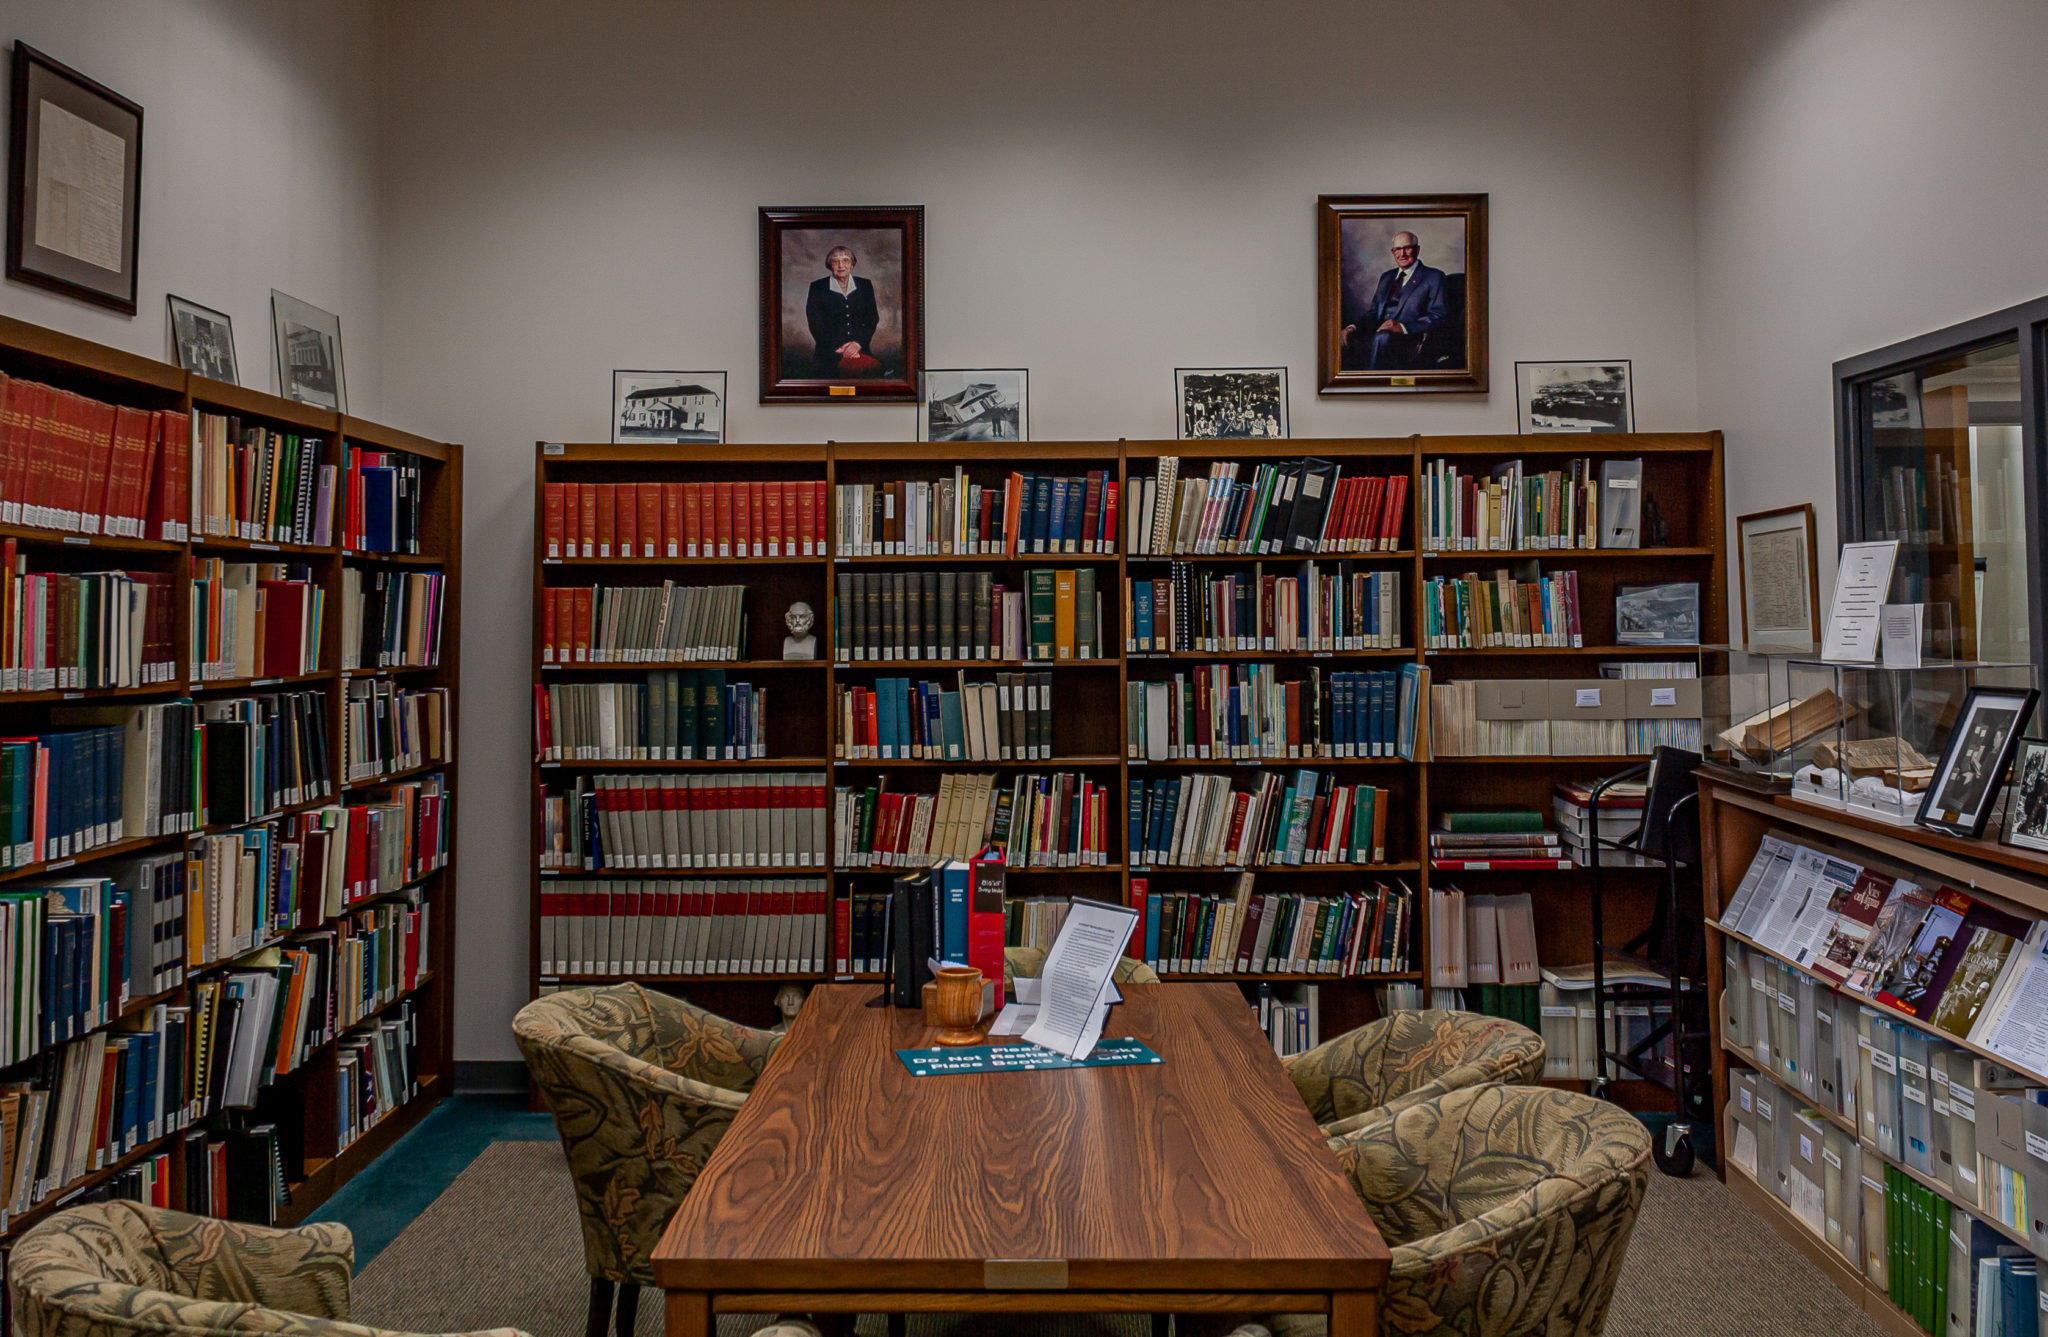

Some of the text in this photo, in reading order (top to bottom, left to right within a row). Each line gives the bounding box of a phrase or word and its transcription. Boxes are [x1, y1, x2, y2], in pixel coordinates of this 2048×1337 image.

[947, 1054, 982, 1062] Not
[930, 1061, 983, 1069] Place
[991, 1058, 1053, 1066] Books
